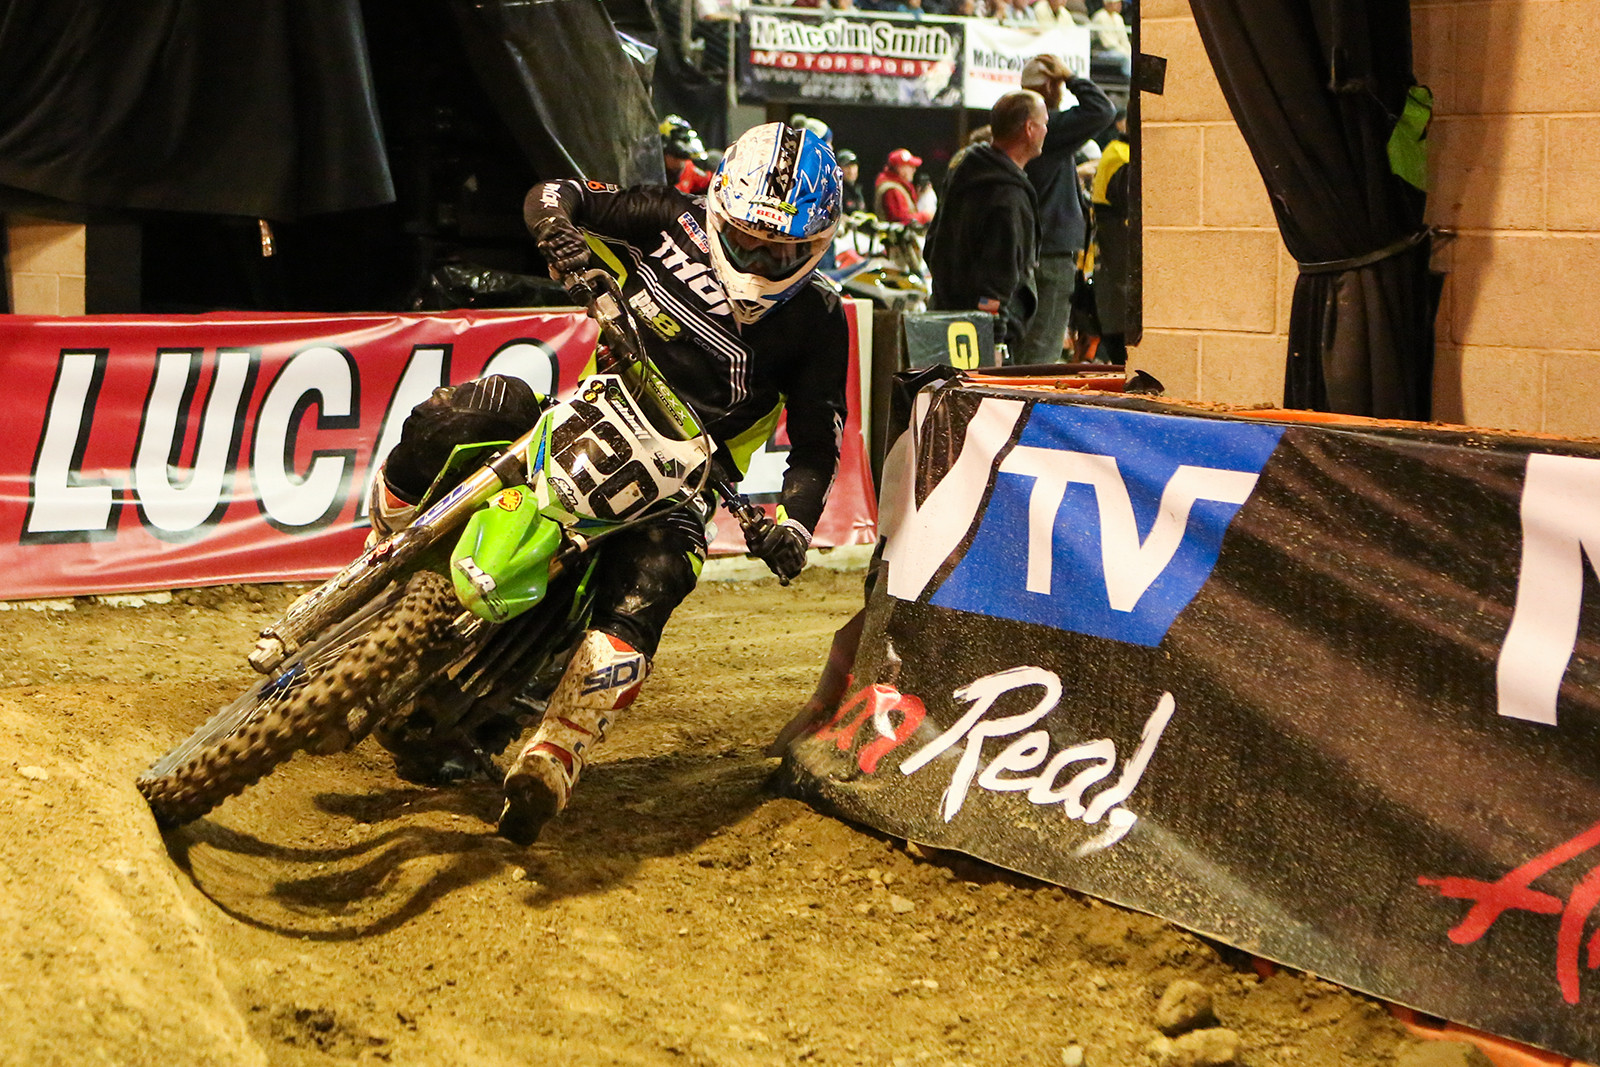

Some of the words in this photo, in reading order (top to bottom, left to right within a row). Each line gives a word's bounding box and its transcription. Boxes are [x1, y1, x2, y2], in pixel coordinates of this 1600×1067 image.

[751, 16, 872, 51] Malcolm
[872, 21, 954, 58] Smith
[752, 51, 945, 76] MOTORSPORT
[756, 209, 785, 223] BELL
[649, 230, 735, 316] THO
